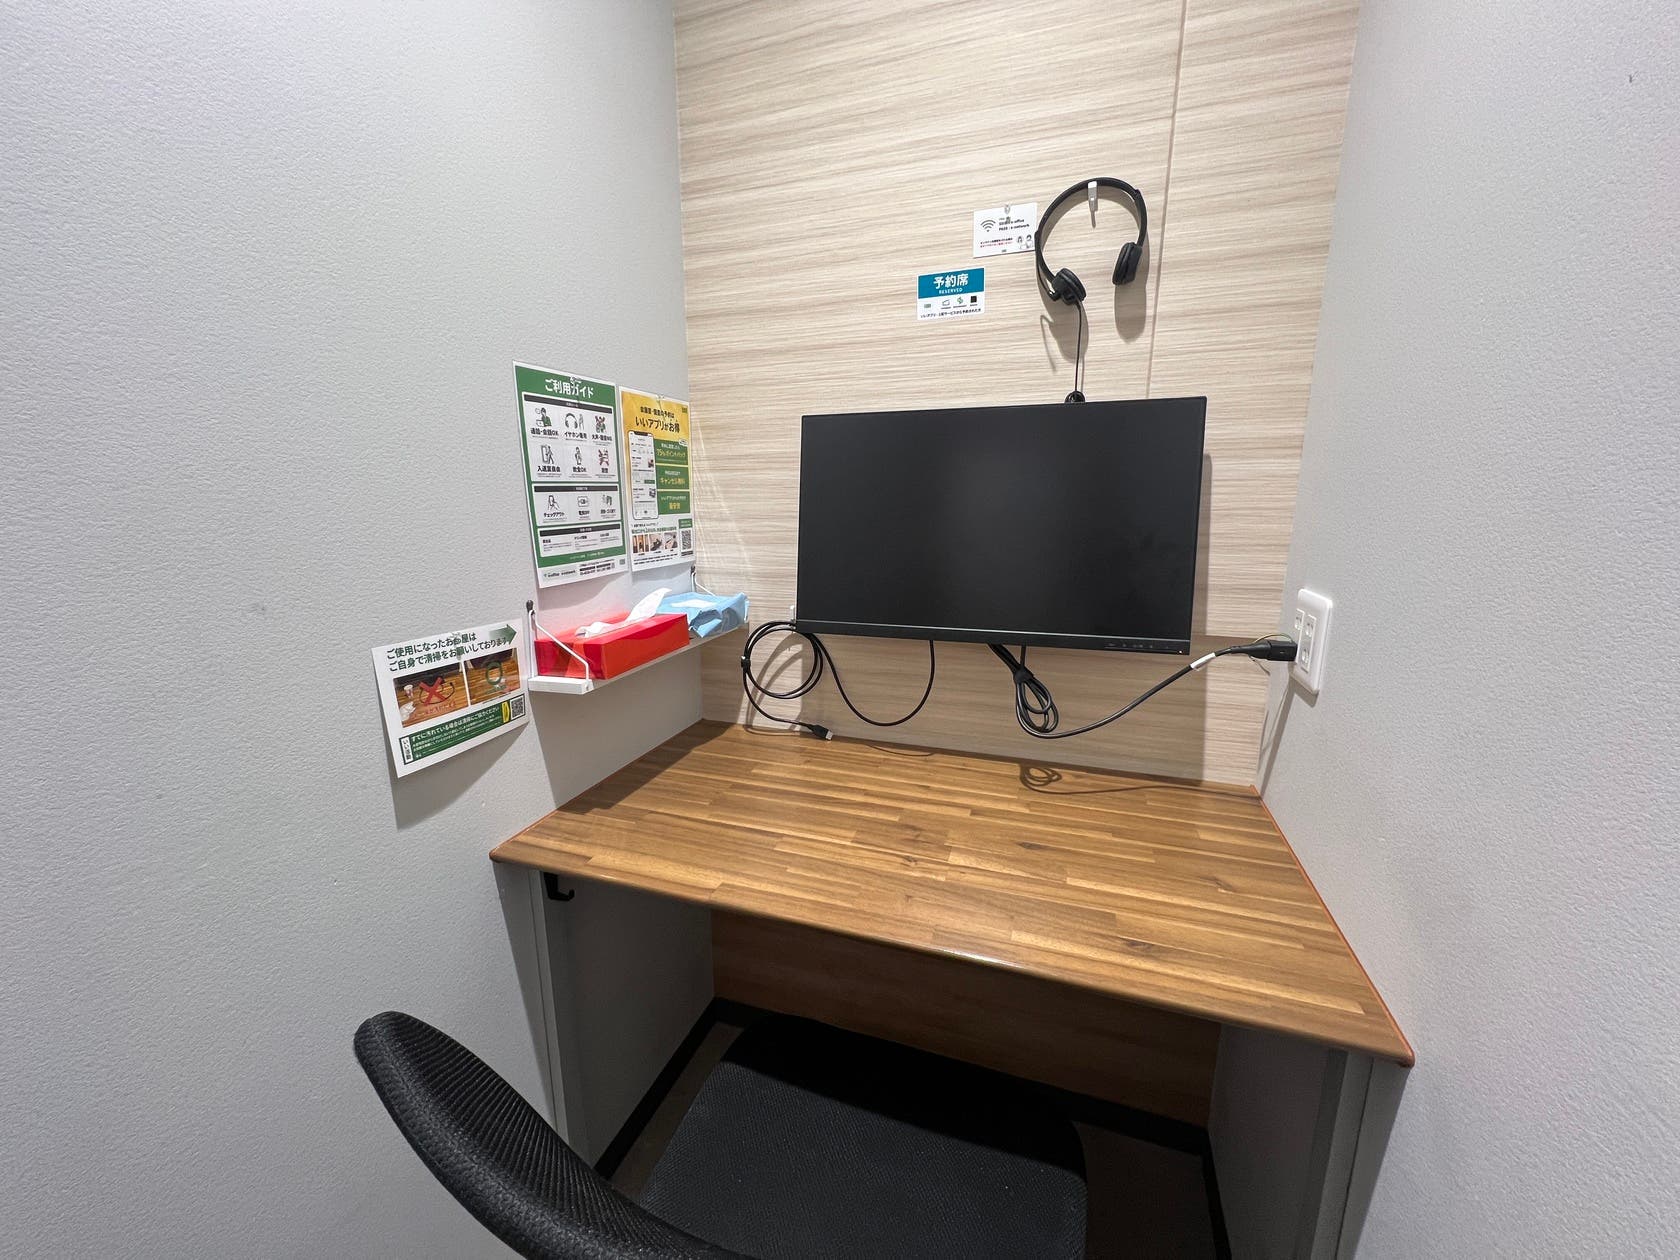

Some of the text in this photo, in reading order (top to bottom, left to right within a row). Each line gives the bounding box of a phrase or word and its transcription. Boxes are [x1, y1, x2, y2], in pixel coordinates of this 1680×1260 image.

[933, 273, 969, 290] 予約席
[938, 287, 963, 295] RESERVED
[544, 378, 594, 399] ご利用ガイド
[635, 416, 681, 433] いいアプリがお得
[386, 632, 477, 660] ご使用になったお部屋は
[389, 636, 510, 672] ご自身で清掃をお願いしております
